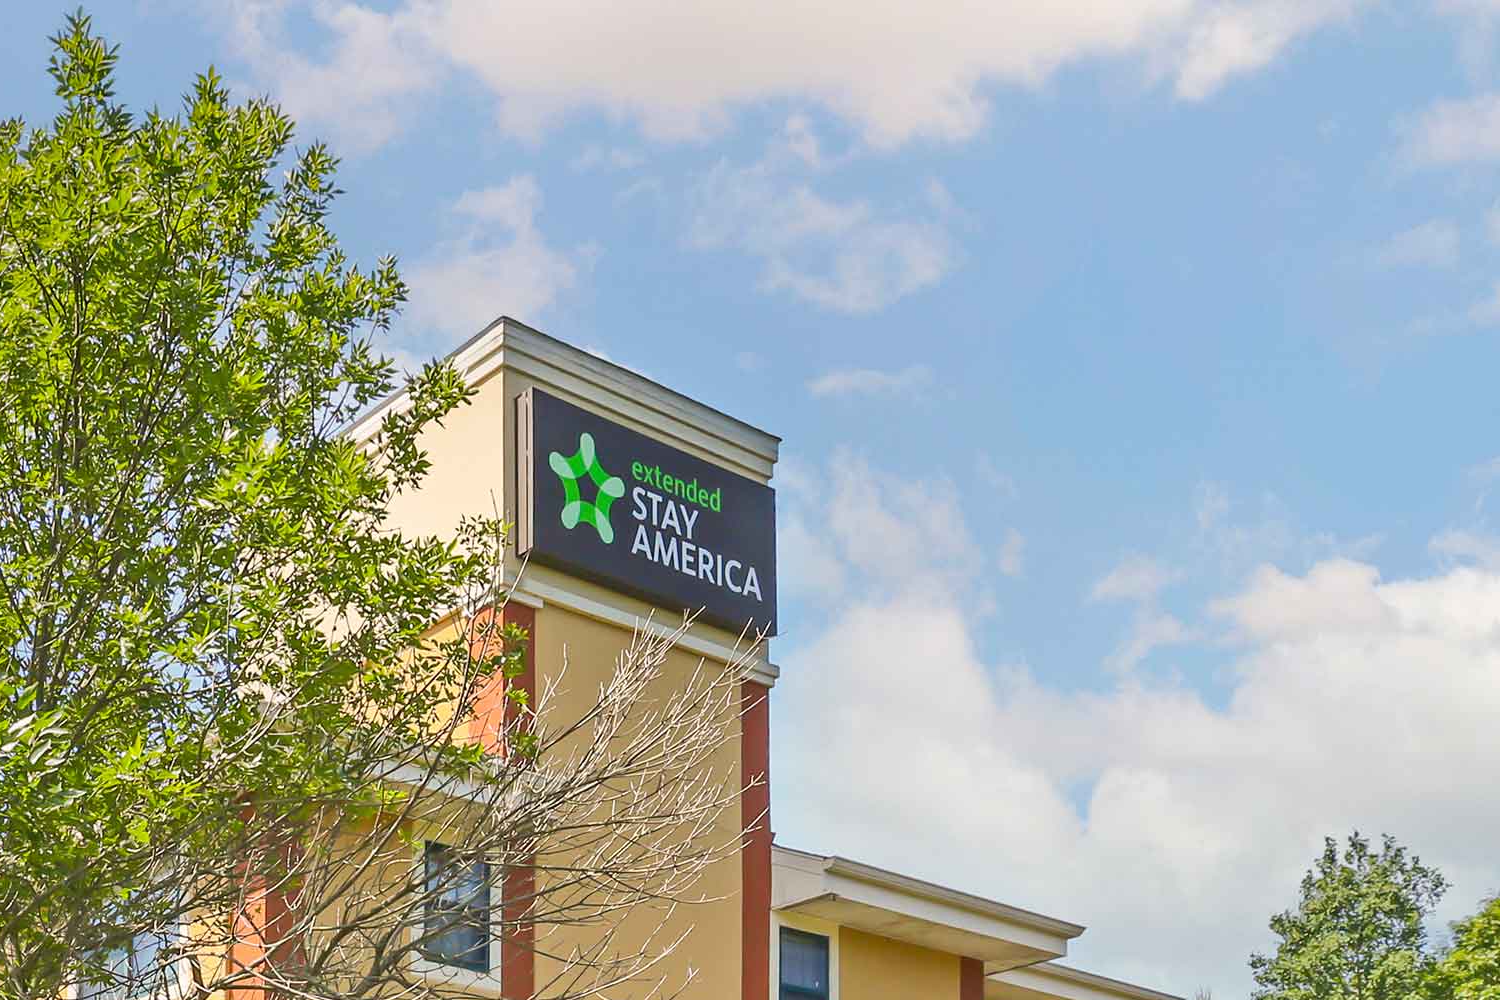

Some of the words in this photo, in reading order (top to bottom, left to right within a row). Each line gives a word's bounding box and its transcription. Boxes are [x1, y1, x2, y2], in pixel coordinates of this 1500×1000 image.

[632, 461, 721, 512] extended
[632, 486, 699, 539] STAY
[631, 524, 763, 602] AMERICA
